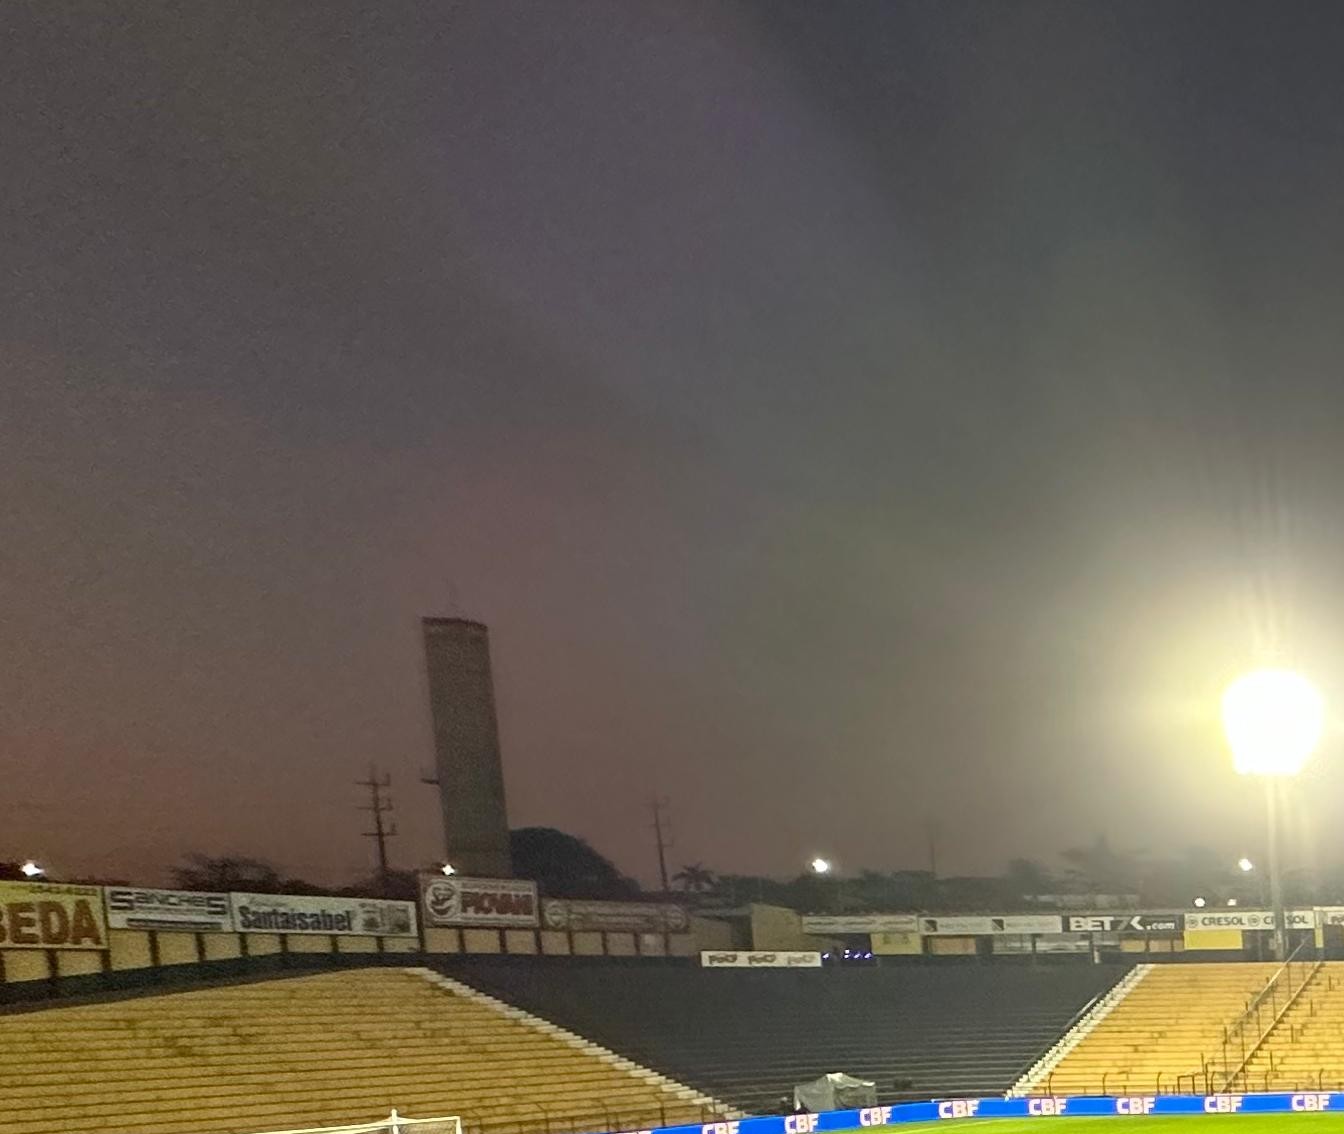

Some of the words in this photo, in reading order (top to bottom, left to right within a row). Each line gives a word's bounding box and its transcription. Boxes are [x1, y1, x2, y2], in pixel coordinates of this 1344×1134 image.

[0, 899, 101, 945] EDA
[1201, 916, 1246, 927] CRESOL
[938, 1100, 979, 1119] CBF
[1028, 1098, 1067, 1116] CBF
[1116, 1097, 1156, 1115] CBF
[1204, 1096, 1243, 1113] CBF
[1291, 1095, 1330, 1112] CBF
[784, 1114, 820, 1134] CBF
[860, 1107, 892, 1127] CBF
